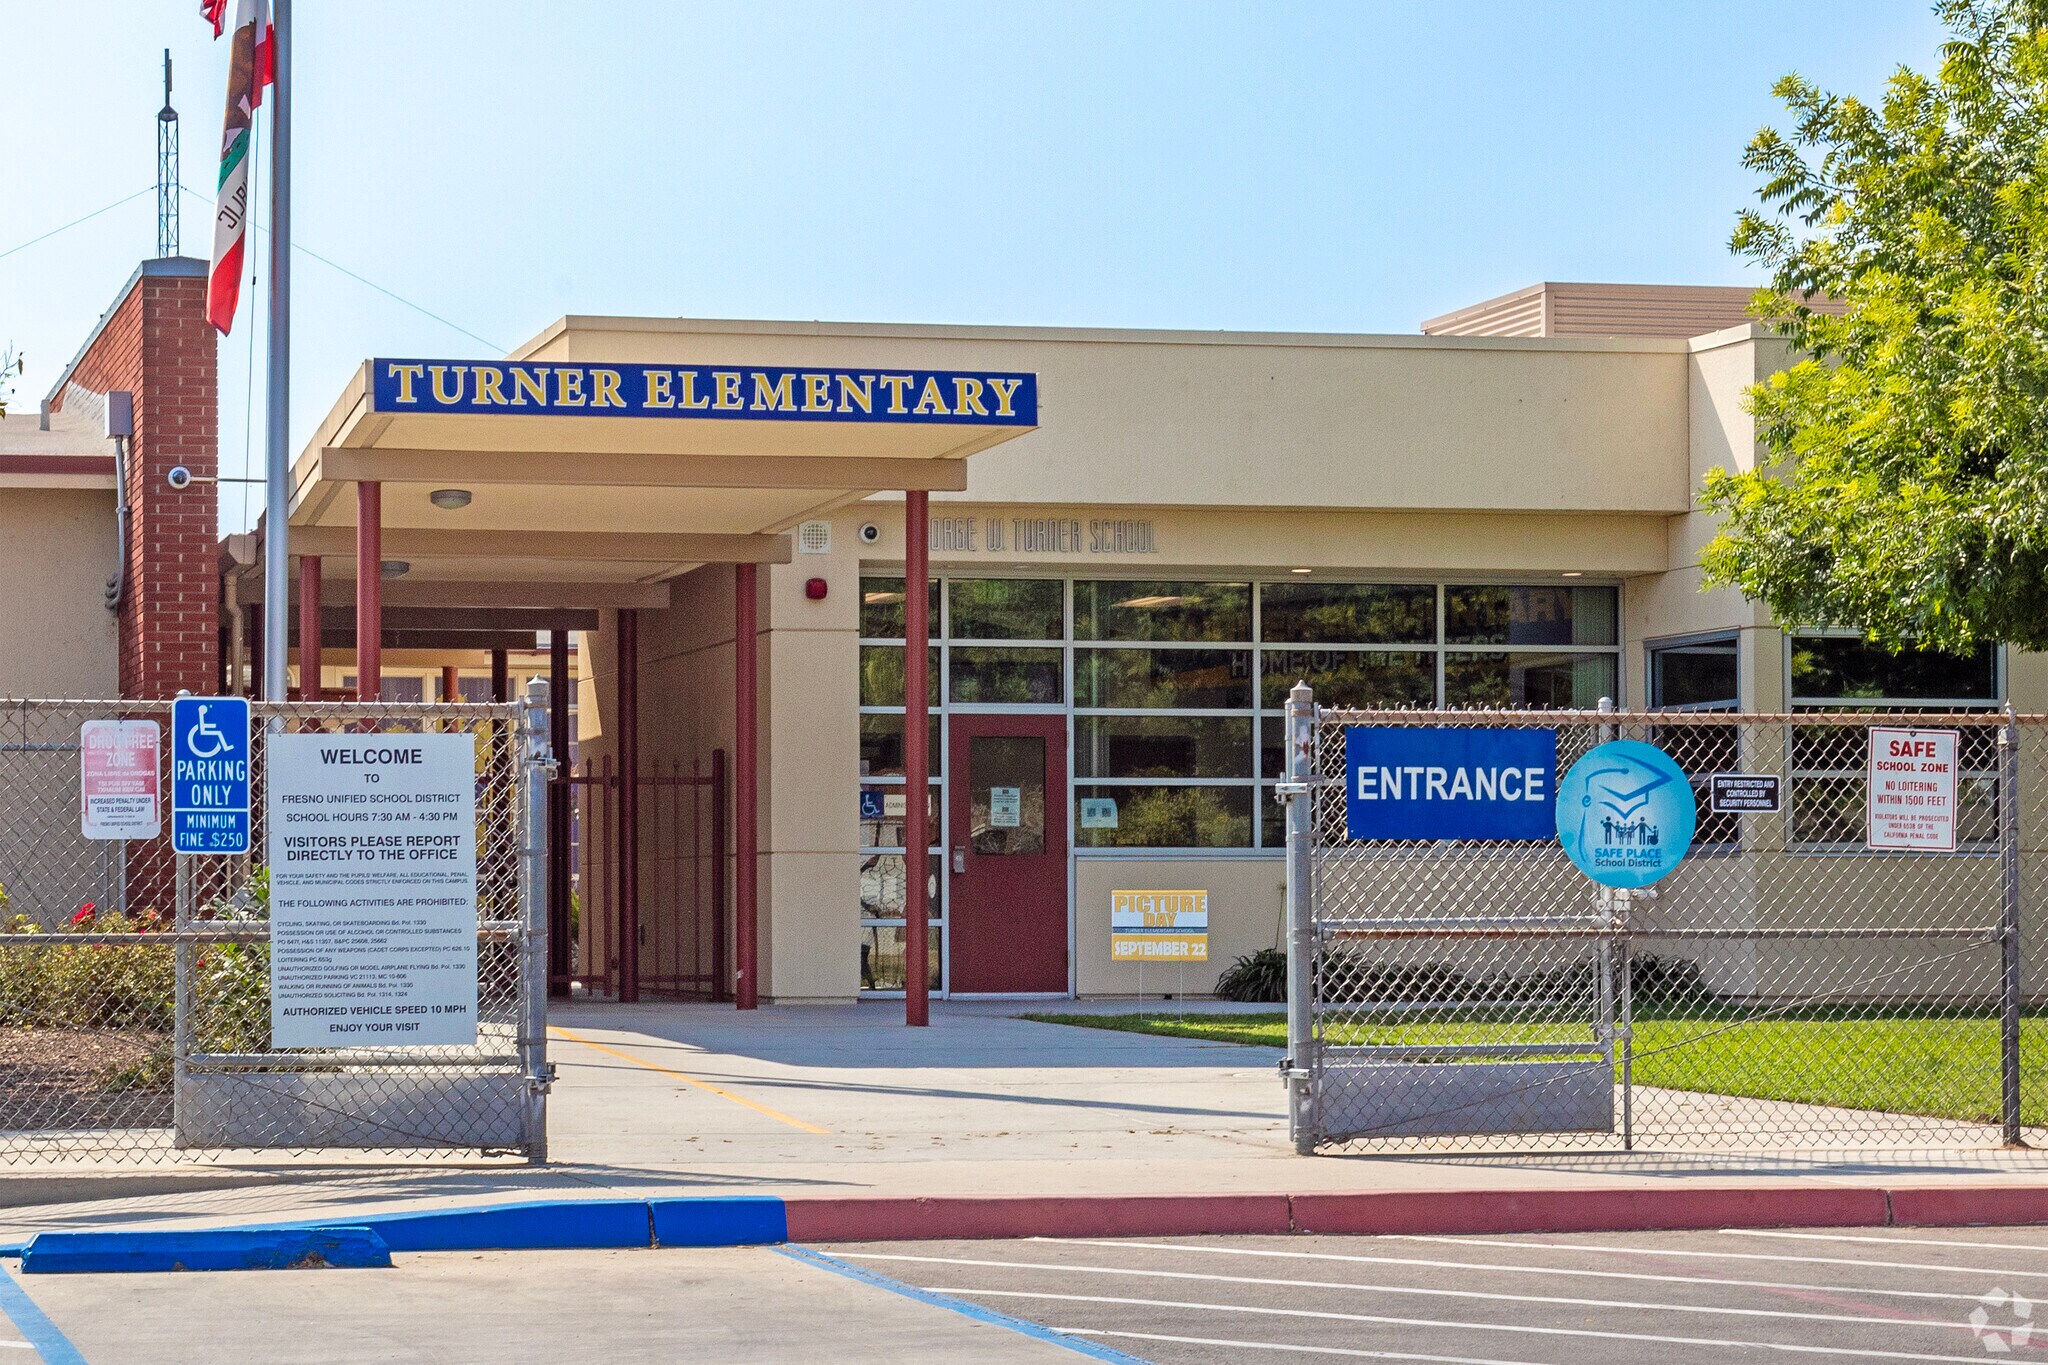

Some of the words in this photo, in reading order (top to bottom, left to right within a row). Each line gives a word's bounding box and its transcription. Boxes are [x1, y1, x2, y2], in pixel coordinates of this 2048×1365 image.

[388, 362, 628, 408] TURNER
[643, 369, 1023, 416] ELEMENTARY
[930, 517, 977, 551] ORGE
[1013, 518, 1081, 553] TURNER
[1090, 518, 1158, 554] SCHOOL
[1889, 740, 1936, 758] SAFE
[106, 752, 135, 767] ZONE
[320, 748, 423, 764] WELCOME
[177, 760, 245, 781] PARKING
[1877, 761, 1916, 772] SCHOOL
[1921, 763, 1949, 773] ZONE
[364, 773, 380, 784] TO
[1357, 766, 1545, 801] ENTRANCE
[1718, 780, 1733, 788] ENTRY
[1734, 780, 1763, 788] RESTRICTED
[1764, 780, 1774, 788] AND
[1886, 781, 1895, 791] NO
[1898, 781, 1938, 792] LOITERING
[191, 785, 232, 806] ONLY
[282, 795, 324, 804] FRESNO
[326, 794, 367, 803] UNIFIED
[370, 794, 412, 803] SCHOOL
[415, 793, 460, 803] DISTRICT
[1726, 790, 1758, 798] CONTROLLED
[1759, 790, 1766, 798] BY
[1877, 794, 1902, 805] WITHIN
[1906, 795, 1924, 806] 1500
[1928, 796, 1946, 806] FEET
[1720, 799, 1743, 807] SECURITY
[1744, 799, 1772, 807] PERSONNEL
[186, 815, 236, 829] MINIMUM
[286, 813, 330, 822] SCHOOL
[332, 812, 368, 822] HOURS
[372, 812, 392, 821] 7:30
[395, 812, 410, 821] AM
[418, 812, 440, 821] 4:30
[442, 812, 458, 821] PM
[180, 832, 205, 847] FINE
[211, 831, 243, 848] $250
[284, 836, 346, 847] VISITORS
[351, 836, 402, 847] PLEASE
[406, 835, 460, 847] REPORT
[287, 850, 353, 861] DIRECTLY
[356, 849, 375, 860] TO
[378, 849, 405, 860] THE
[409, 849, 457, 860] OFFICE
[1595, 848, 1623, 858] SAFE
[1626, 848, 1662, 858] PLACE
[1595, 858, 1625, 867] School
[1628, 858, 1662, 867] District
[278, 899, 295, 908] THE
[298, 899, 348, 907] FOLLOWING
[350, 899, 394, 907] ACTIVITIES
[397, 898, 413, 906] ARE
[416, 898, 468, 906] PROHIBITED:
[1114, 895, 1206, 913] PICTURE
[1143, 912, 1177, 928] DAY
[1114, 941, 1189, 956] SEPTEMBER
[1191, 943, 1206, 956] 22
[283, 1007, 347, 1016] AUTHORIZED
[350, 1006, 392, 1015] VEHICLE
[395, 1005, 427, 1014] SPEED
[431, 1005, 442, 1014] 10
[444, 1005, 466, 1014] MPH
[330, 1023, 362, 1033] ENJOY
[366, 1023, 392, 1032] YOUR
[396, 1023, 420, 1031] VISIT
